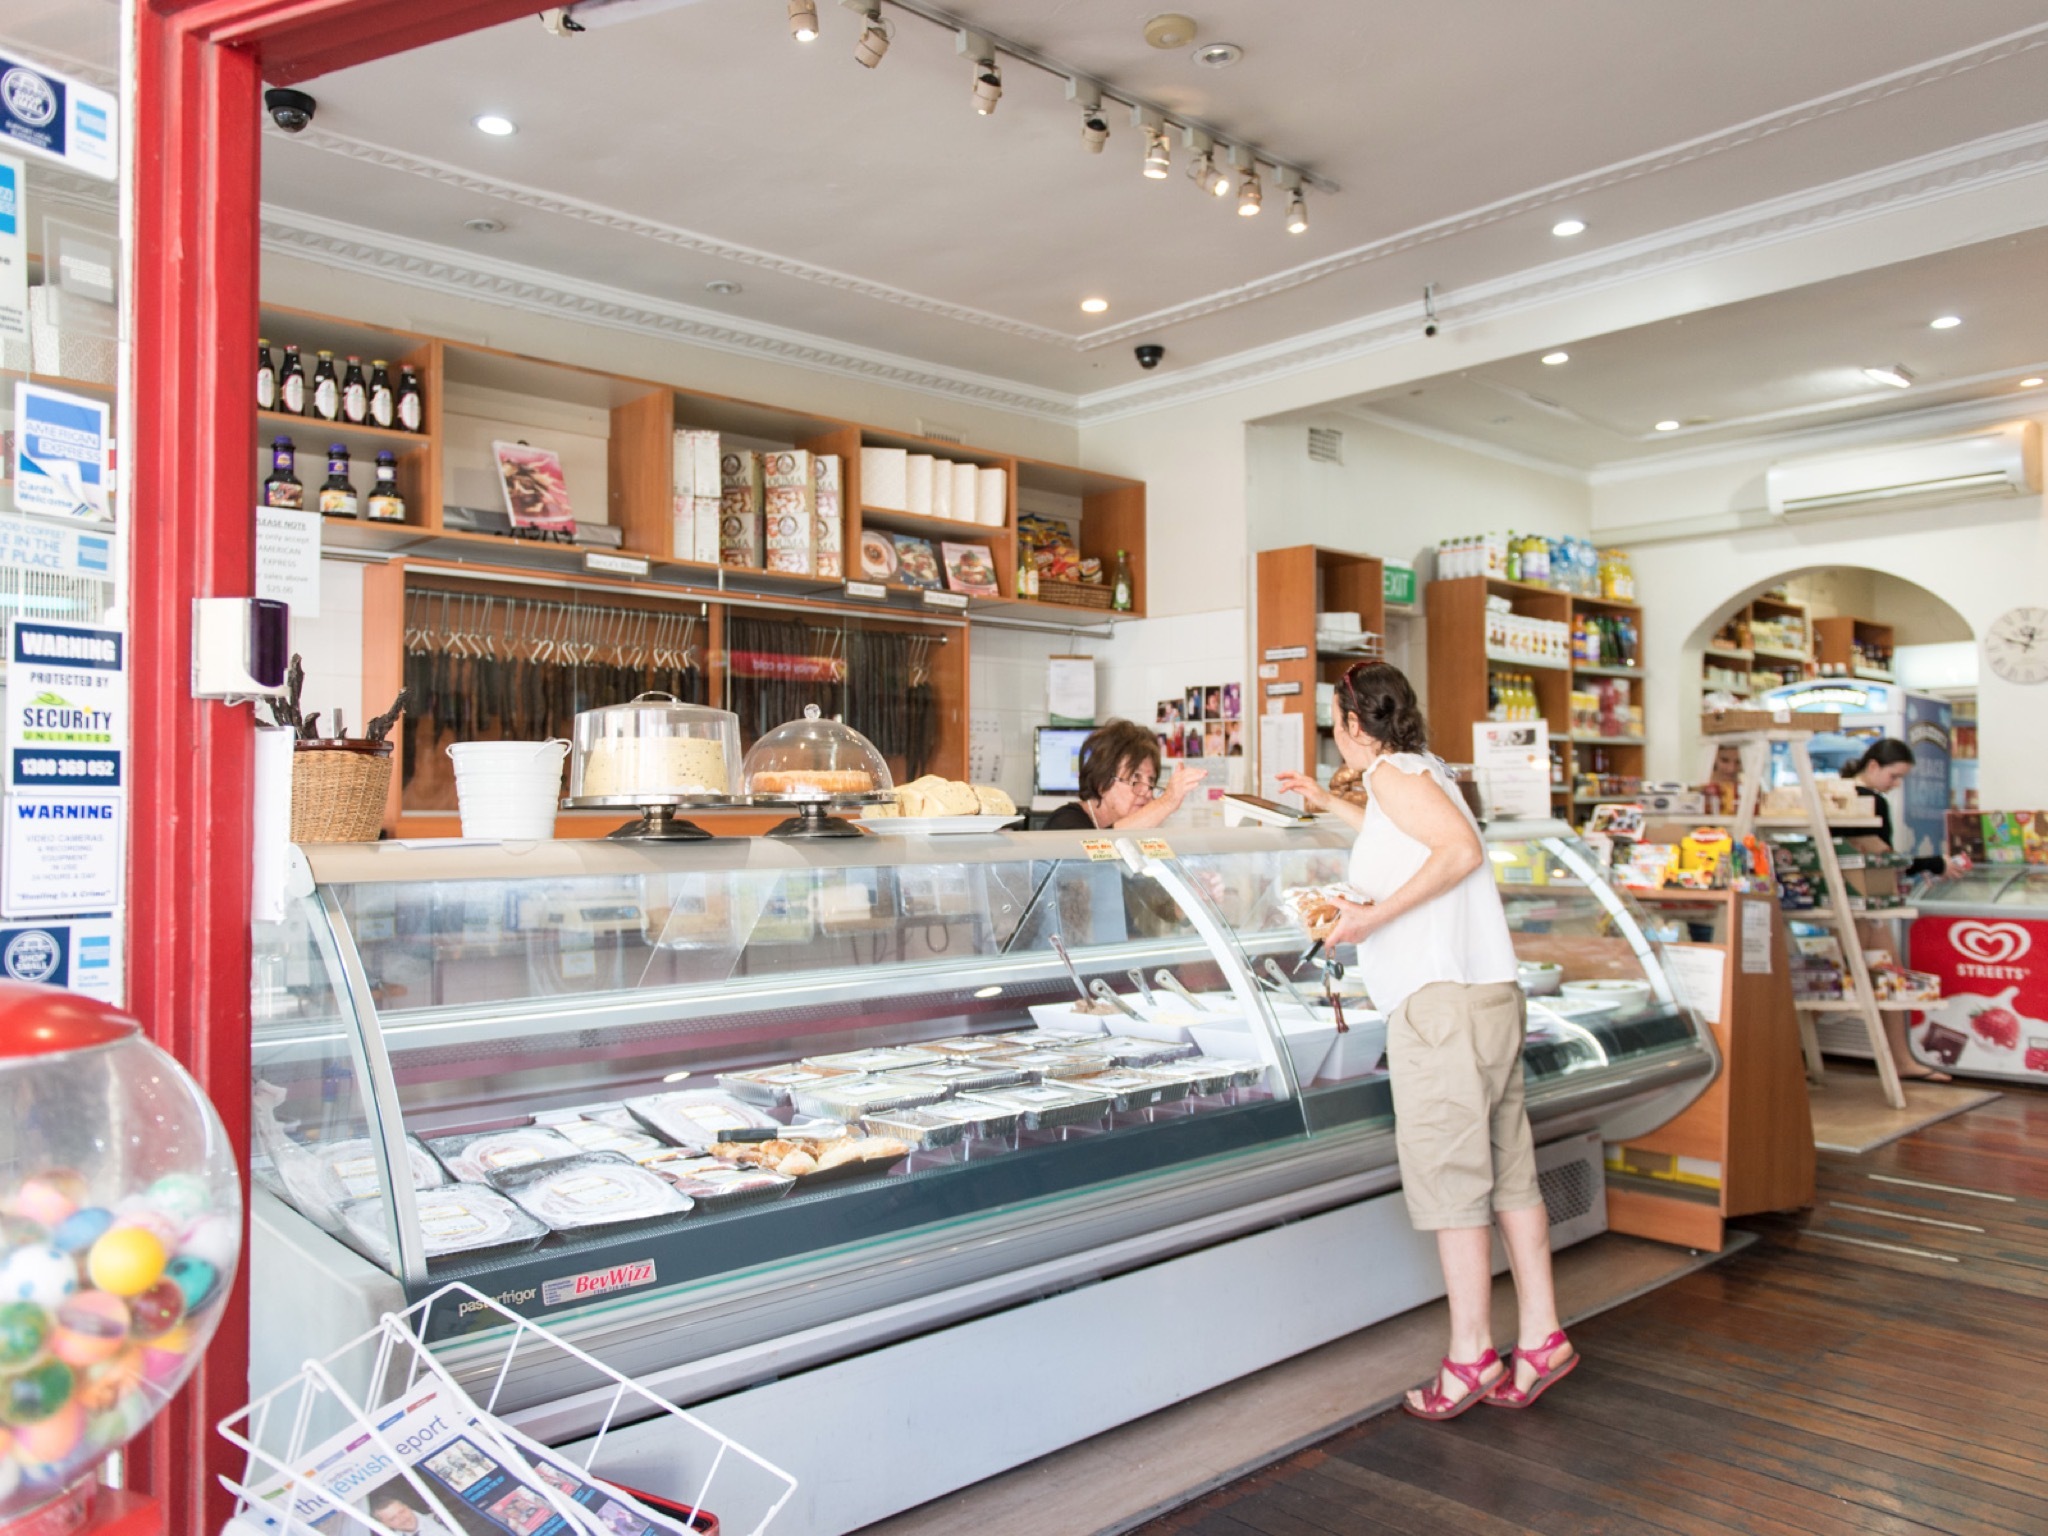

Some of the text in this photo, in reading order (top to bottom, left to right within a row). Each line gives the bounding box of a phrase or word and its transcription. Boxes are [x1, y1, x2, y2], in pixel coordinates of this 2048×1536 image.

[26, 421, 98, 446] AMERICAN
[40, 440, 100, 461] EXPRESS
[18, 480, 54, 494] Cards
[768, 476, 802, 486] OUMA
[19, 491, 73, 508] Welcome
[284, 520, 306, 531] NOTE
[14, 535, 29, 547] IN
[34, 538, 61, 553] THE
[284, 535, 310, 545] accept
[770, 538, 805, 548] OUMA
[258, 544, 302, 555] AMERICAN
[263, 557, 297, 568] EXPRESS
[1384, 570, 1409, 598] EXIT
[21, 631, 116, 662] WARNING
[30, 671, 109, 688] PROTECTED BY
[23, 731, 111, 742] UNLIMITED
[20, 758, 57, 776] 1300
[18, 804, 113, 819] WARNING
[26, 834, 104, 842] VIDEO CAMERAS
[41, 853, 88, 862] EQUIPMENT
[18, 953, 47, 962] SHOP
[15, 961, 48, 971] SMALL
[1956, 963, 2025, 980] STREETS
[575, 1264, 652, 1295] BevWizz
[393, 1413, 449, 1457] eport
